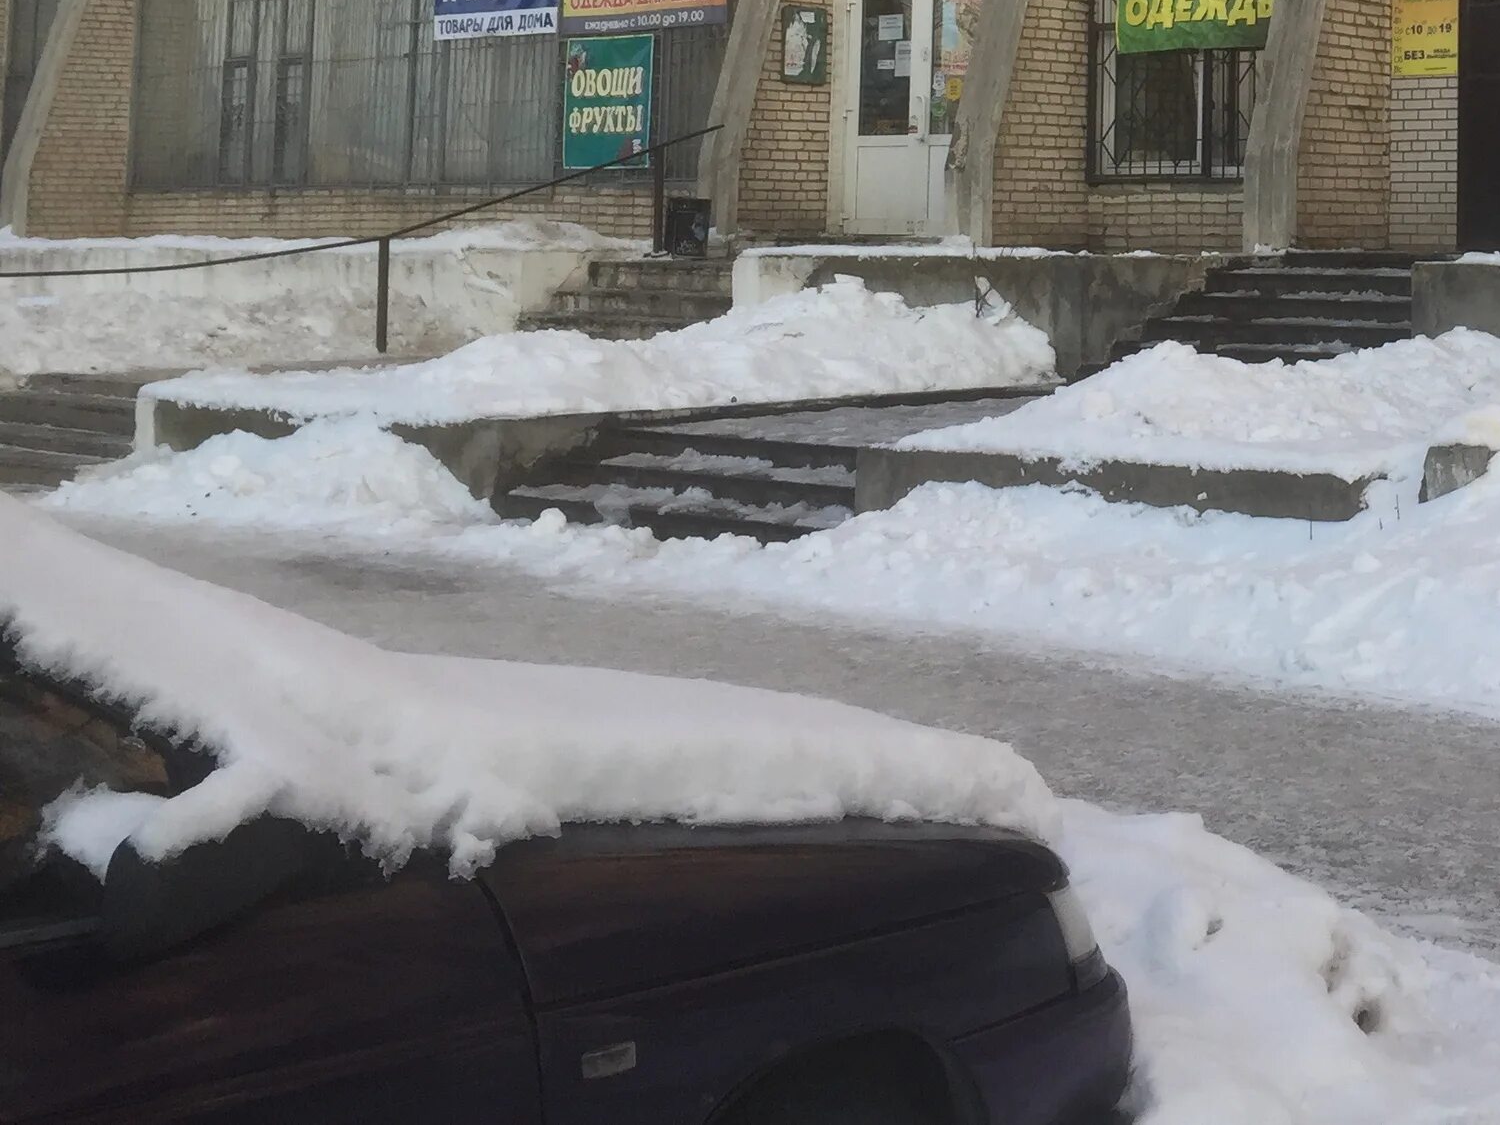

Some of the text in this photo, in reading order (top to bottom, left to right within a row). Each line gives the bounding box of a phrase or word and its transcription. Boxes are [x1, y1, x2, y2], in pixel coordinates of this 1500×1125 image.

[438, 12, 554, 35] ТОВАРЫ ДЛЯ ДОМА
[637, 14, 662, 27] 10.00
[677, 10, 704, 23] 19.00
[1404, 49, 1425, 60] БЕЗ
[571, 66, 644, 98] ОВОЩИ
[569, 104, 643, 133] ФРУКТЫ
